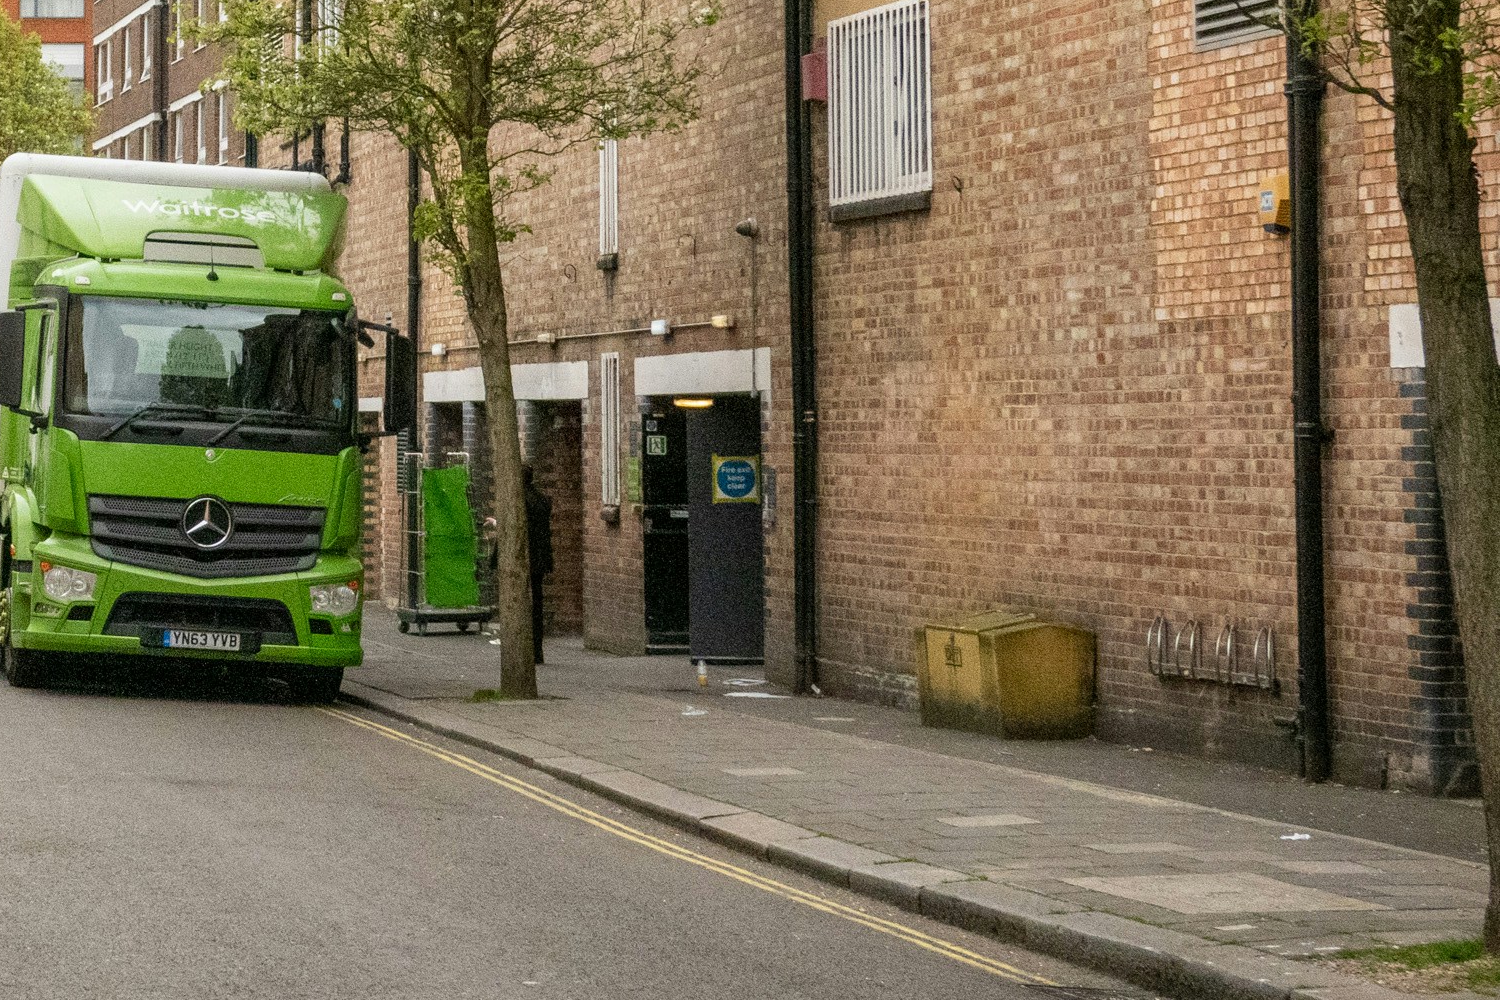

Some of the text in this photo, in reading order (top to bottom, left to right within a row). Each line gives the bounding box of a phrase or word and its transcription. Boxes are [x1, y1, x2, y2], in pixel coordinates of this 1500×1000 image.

[122, 199, 277, 223] Waitrose
[727, 474, 746, 482] keep
[173, 631, 238, 647] YN63 YVB
